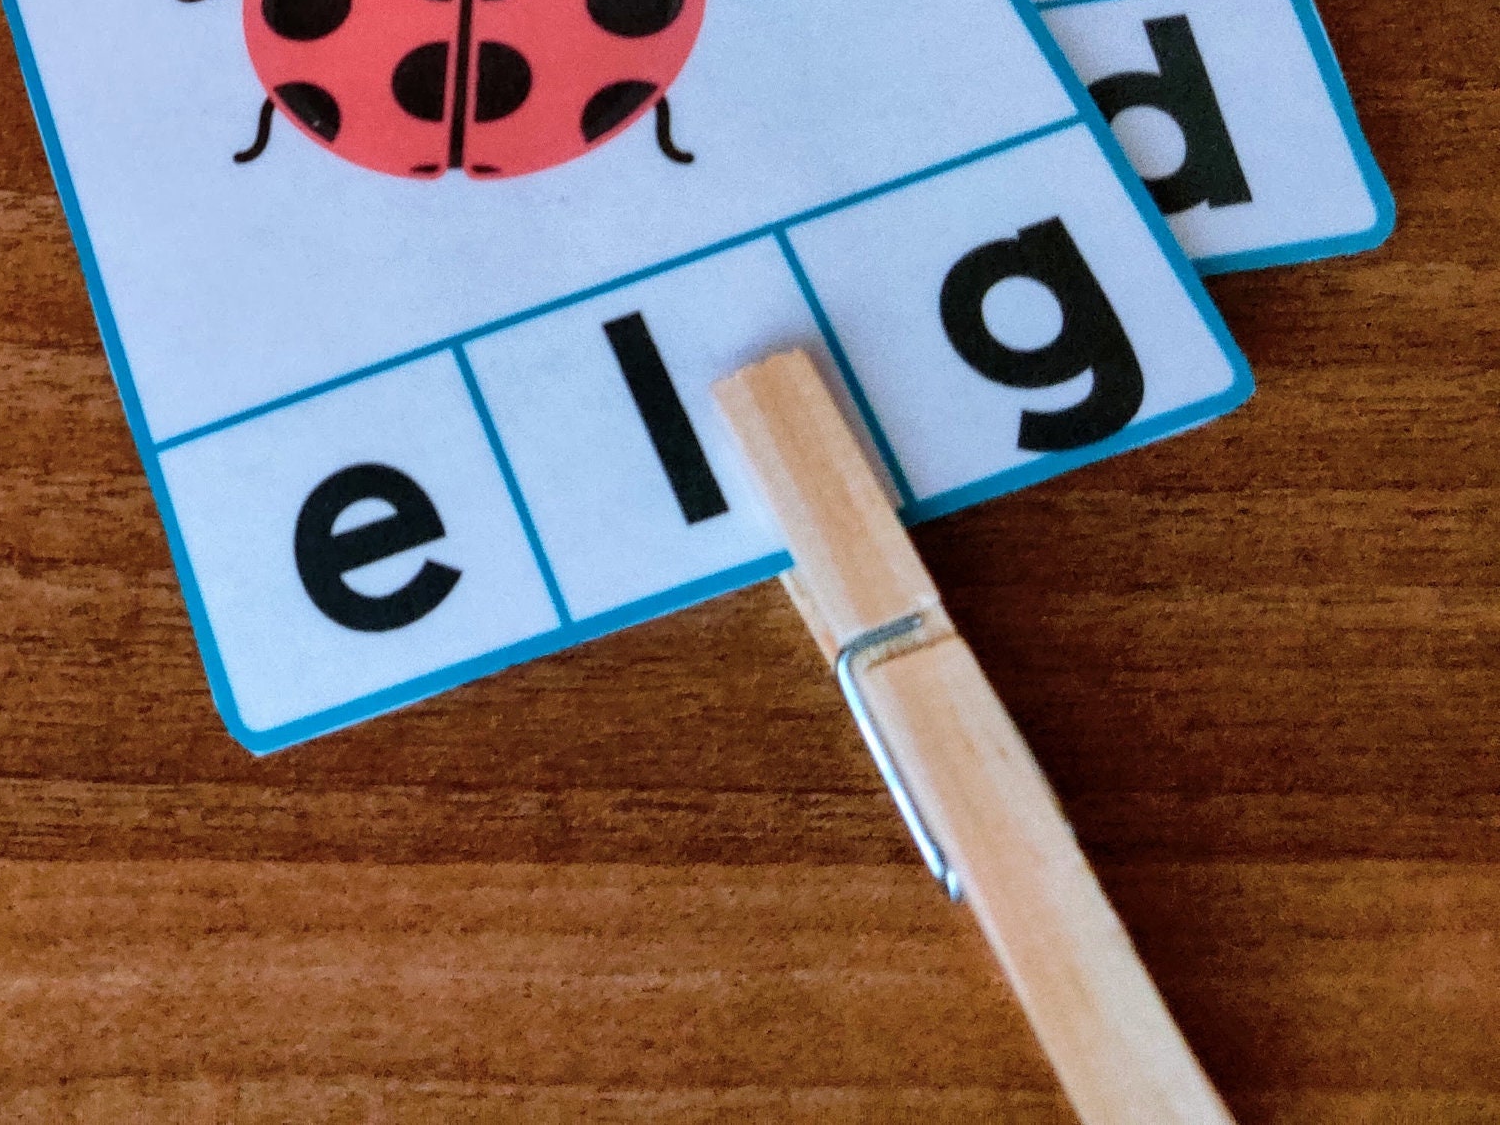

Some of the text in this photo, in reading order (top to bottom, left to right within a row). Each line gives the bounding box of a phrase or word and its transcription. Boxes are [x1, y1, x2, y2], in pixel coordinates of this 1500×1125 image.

[1087, 13, 1253, 217] d
[293, 462, 463, 633] e
[938, 215, 1146, 453] g
